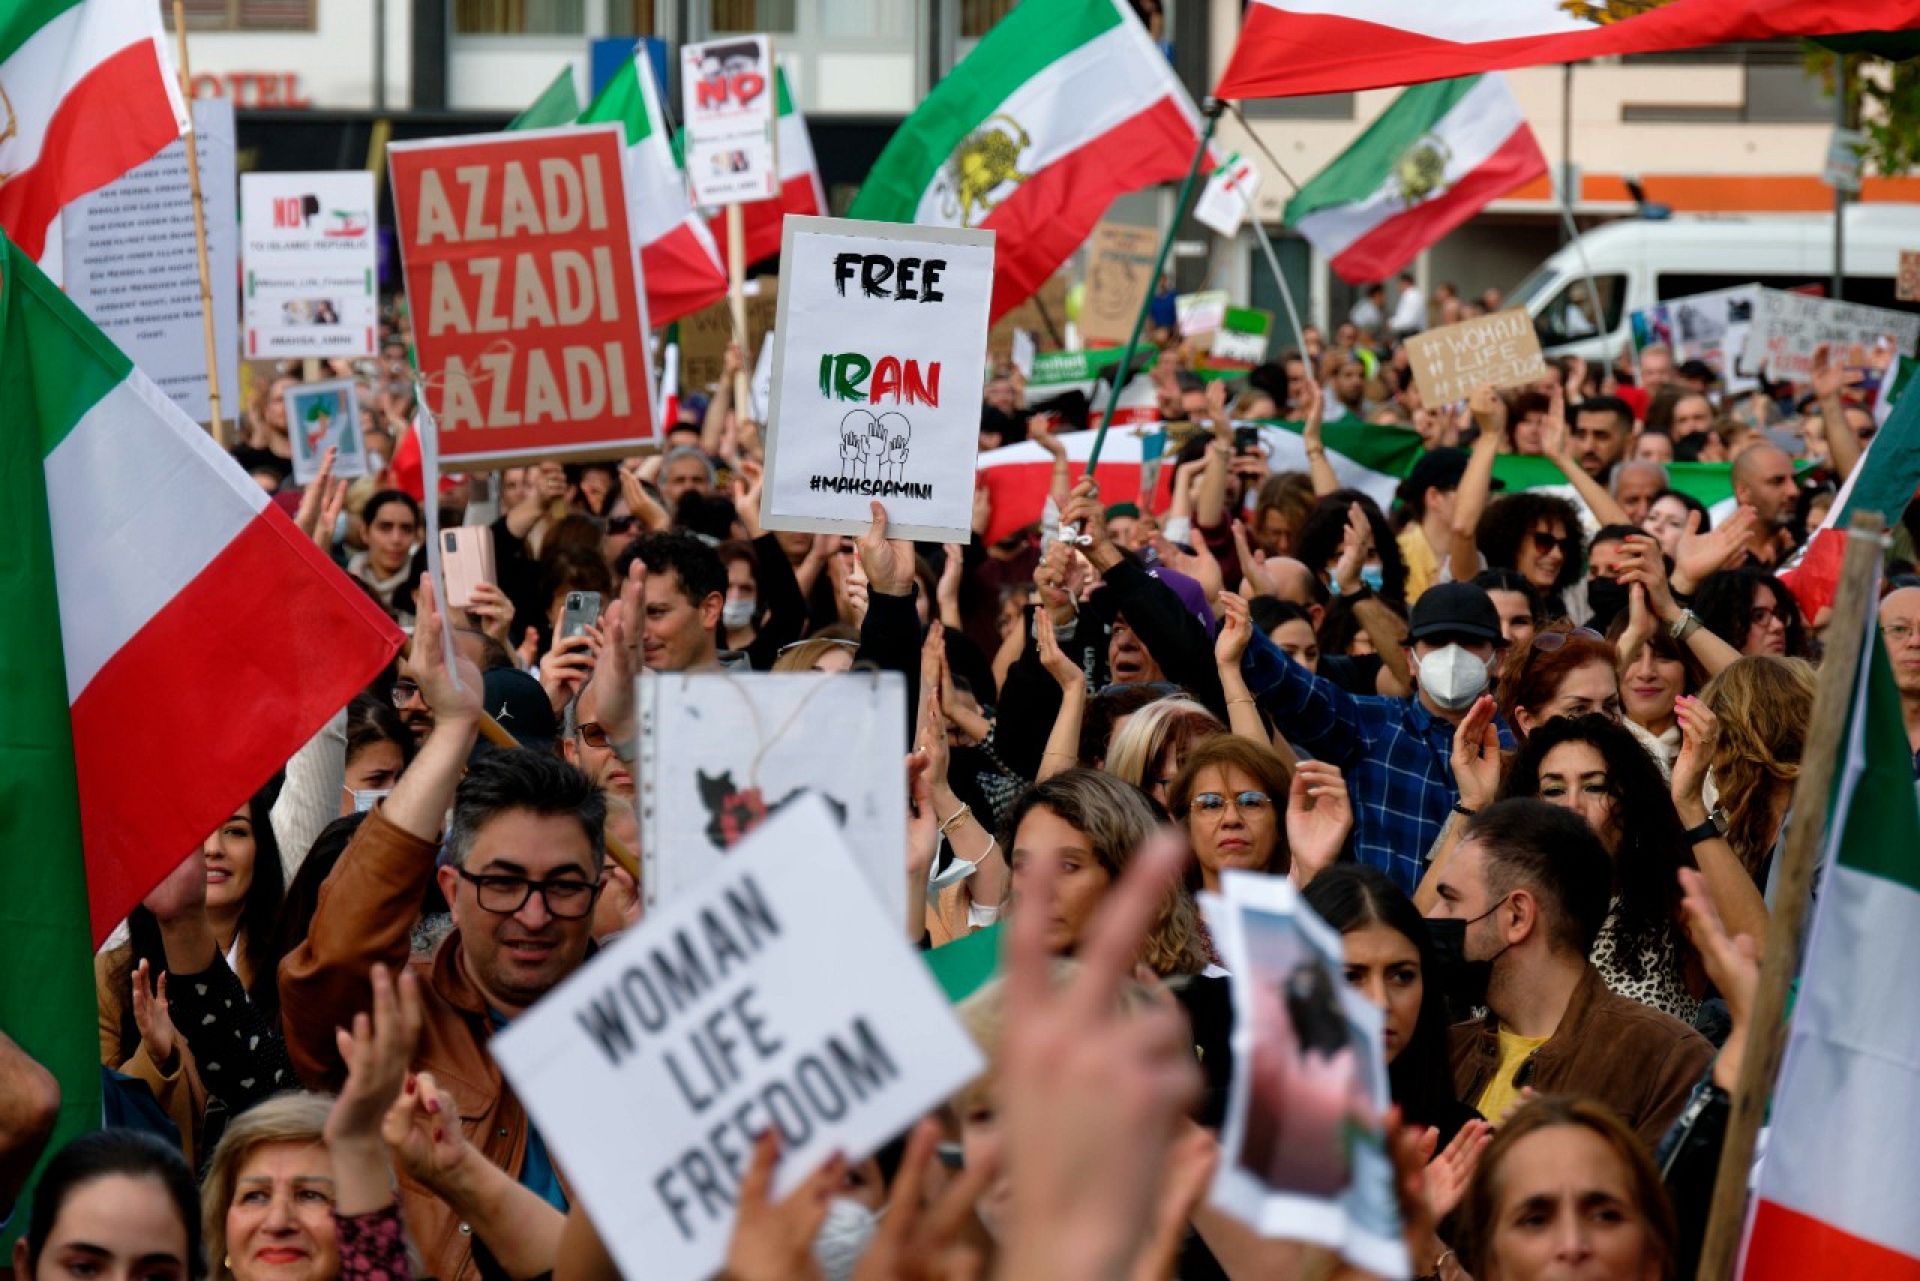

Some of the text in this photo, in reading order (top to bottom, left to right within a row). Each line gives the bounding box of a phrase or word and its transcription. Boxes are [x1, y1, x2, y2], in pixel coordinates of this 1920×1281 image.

[182, 72, 312, 109] OTEL
[696, 72, 765, 110] NO
[416, 153, 608, 246] AZADI
[428, 246, 620, 336] AZADI
[833, 252, 947, 303] FREE
[440, 342, 631, 432] AZADI
[819, 352, 941, 409] IRAN
[810, 475, 932, 500] #MAHSAAMINI
[574, 872, 783, 1068] WOMAN
[661, 982, 785, 1114] LIFE
[651, 1014, 902, 1242] FREEDOM
